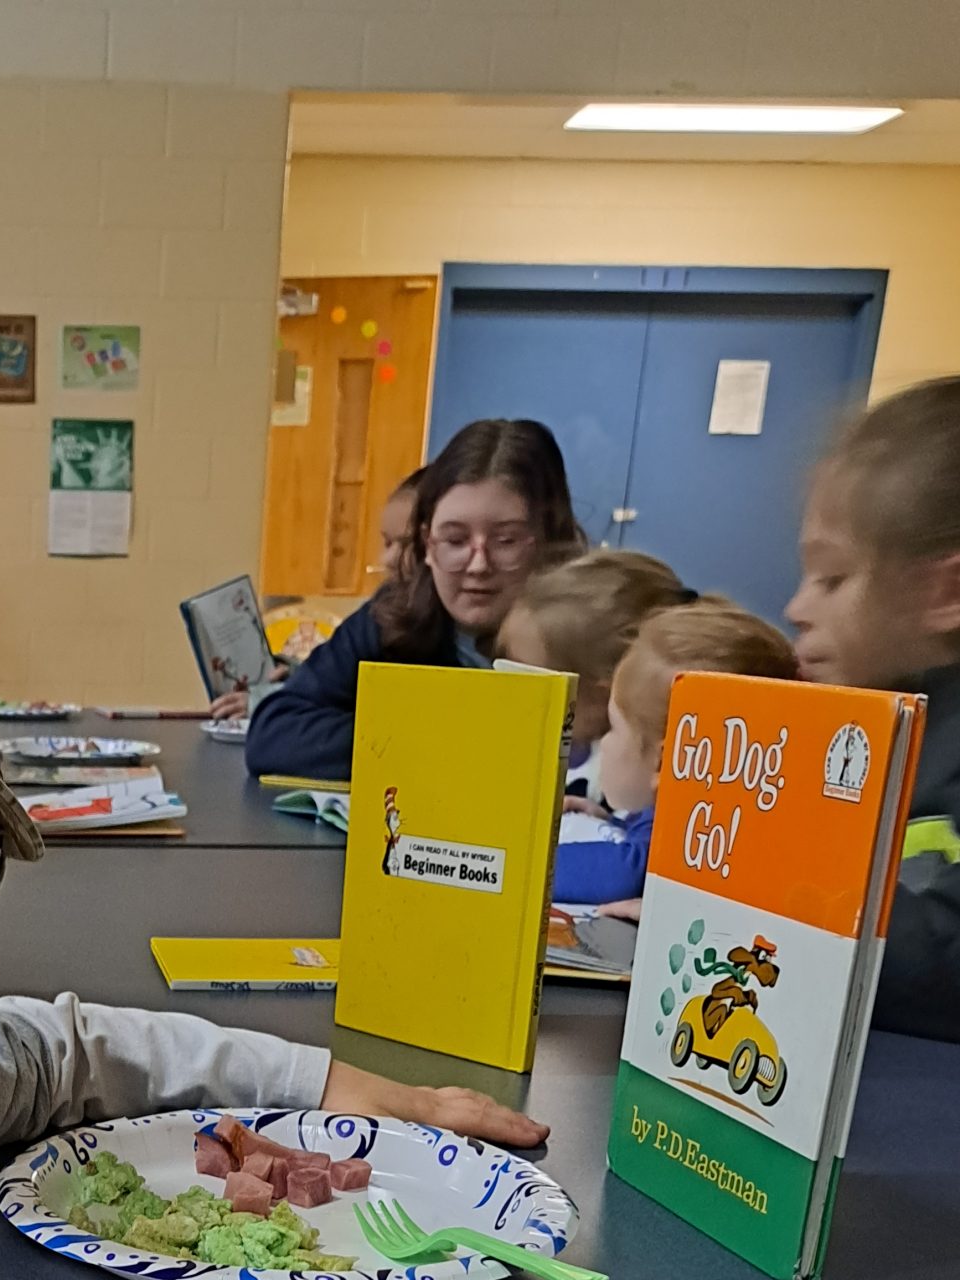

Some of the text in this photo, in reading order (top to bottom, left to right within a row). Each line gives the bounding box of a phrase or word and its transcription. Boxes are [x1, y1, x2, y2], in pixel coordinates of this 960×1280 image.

[671, 712, 713, 791] Go,
[412, 843, 424, 852] CAN
[426, 845, 441, 855] READ
[442, 847, 448, 856] IT
[449, 849, 460, 858] ALL
[471, 853, 495, 863] MYSELF
[683, 800, 742, 879] Go!
[403, 854, 498, 885] Beginner Books
[631, 1104, 652, 1143] by
